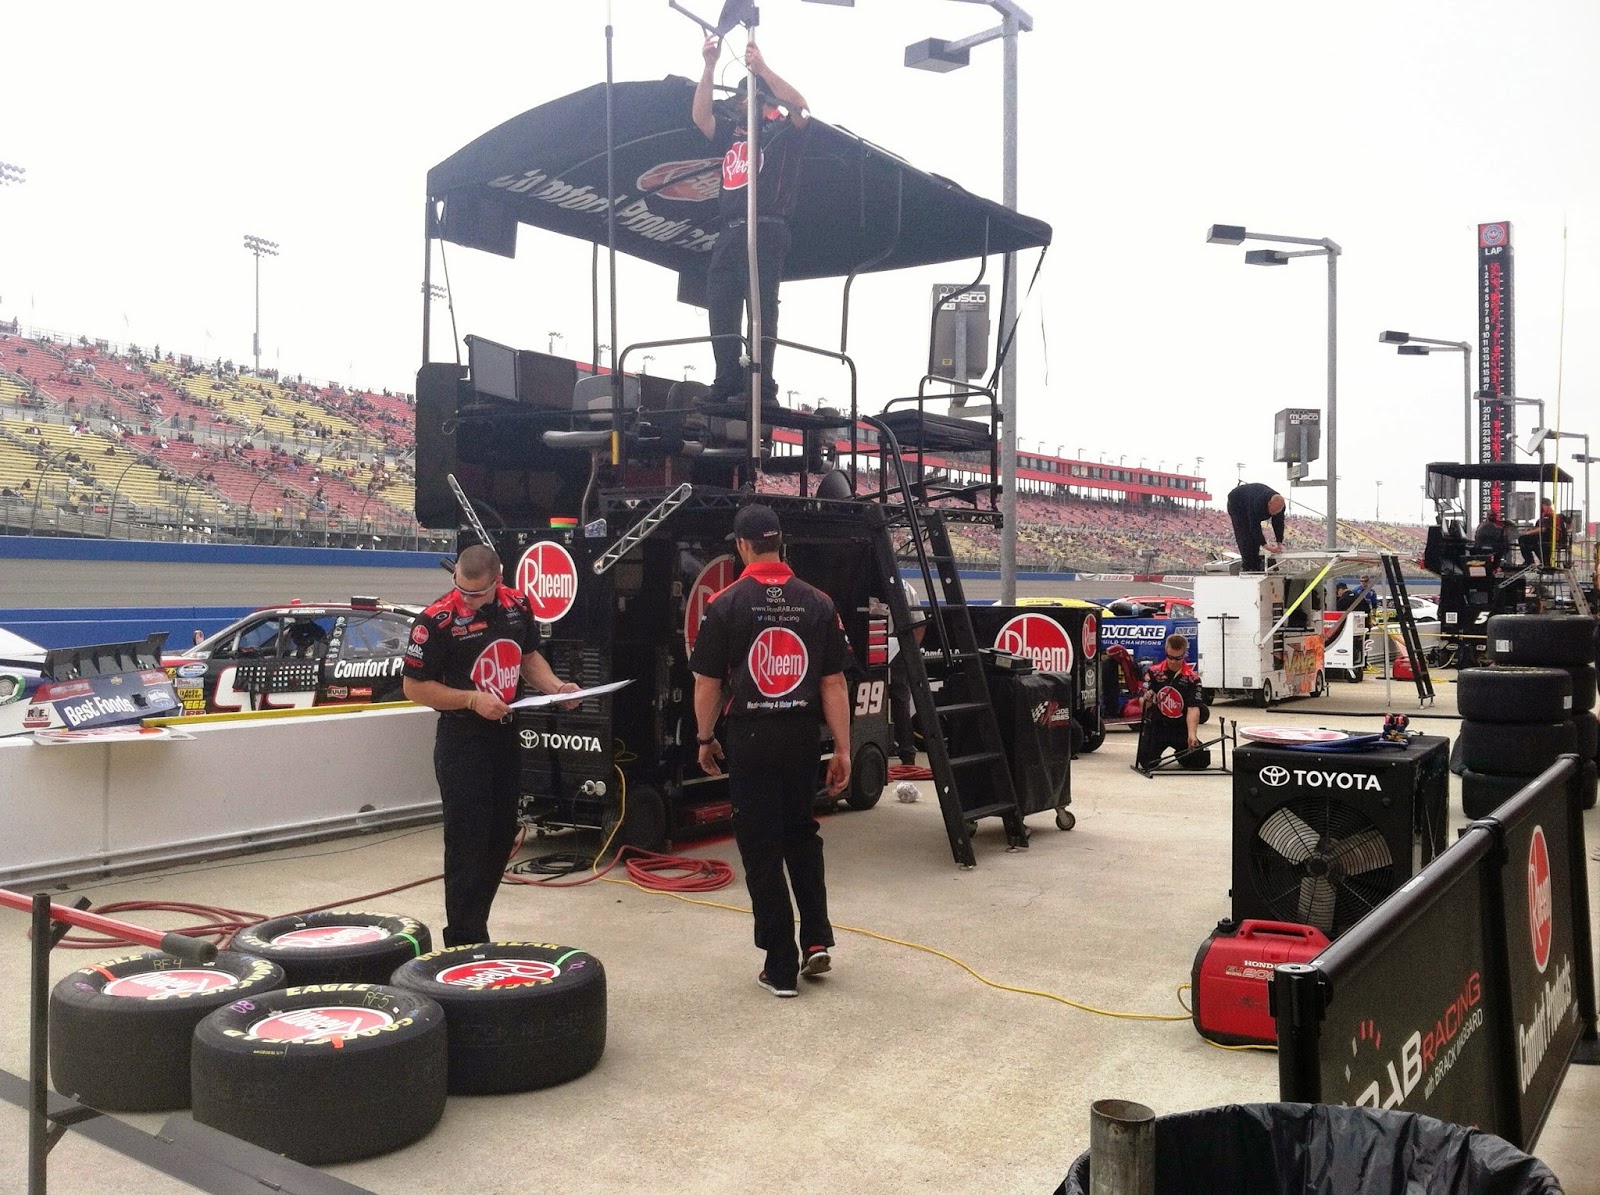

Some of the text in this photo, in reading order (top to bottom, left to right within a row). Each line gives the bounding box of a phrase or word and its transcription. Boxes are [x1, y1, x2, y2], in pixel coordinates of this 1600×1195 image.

[1485, 246, 1503, 255] LAP
[524, 546, 572, 609] Rheem
[1101, 626, 1165, 638] DVOCARE
[1005, 618, 1067, 672] Rheem
[334, 659, 390, 678] Comfort
[757, 631, 803, 686] Rheem
[854, 680, 885, 716] 99
[1081, 688, 1097, 700] TOYOT
[64, 700, 100, 726] Best
[93, 695, 136, 714] Foods
[541, 732, 602, 752] TOYOTA
[1294, 770, 1382, 792] TOYOTA
[78, 954, 144, 975] EGLE
[1244, 960, 1274, 969] HOND
[286, 984, 372, 996] EAGLE
[1422, 972, 1481, 1072] RACING
[1434, 1046, 1458, 1086] BRACK
